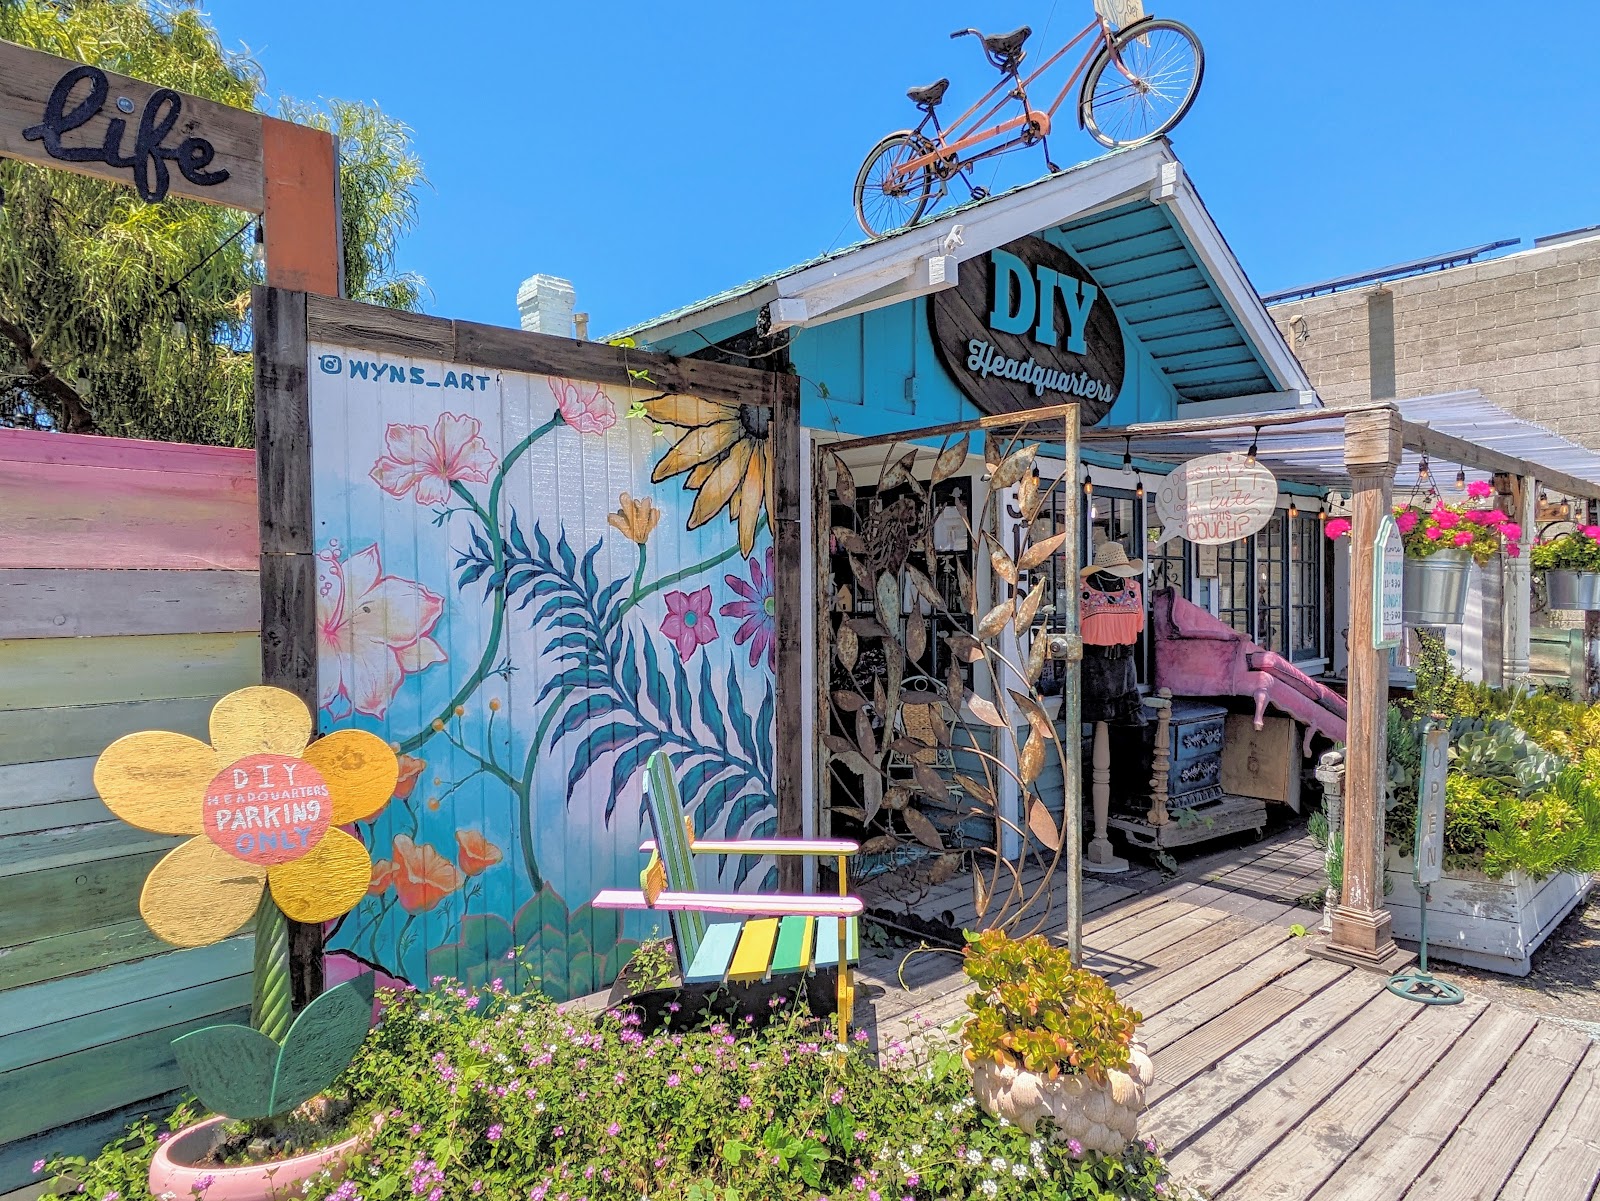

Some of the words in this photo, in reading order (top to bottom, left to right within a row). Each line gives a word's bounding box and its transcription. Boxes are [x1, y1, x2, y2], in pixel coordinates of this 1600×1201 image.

[22, 65, 232, 203] life
[989, 248, 1098, 356] DIY
[349, 359, 490, 392] WYNS_ART
[967, 338, 1114, 403] Headquarters
[1162, 472, 1262, 504] OUTFIT
[1209, 491, 1265, 511] cute
[1186, 515, 1250, 541] COUCH?
[1209, 510, 1232, 521] THIS
[233, 763, 298, 789] DIY
[207, 784, 329, 806] HEADQUARTERS
[1426, 747, 1442, 867] OPEN
[236, 825, 312, 854] ONLY
